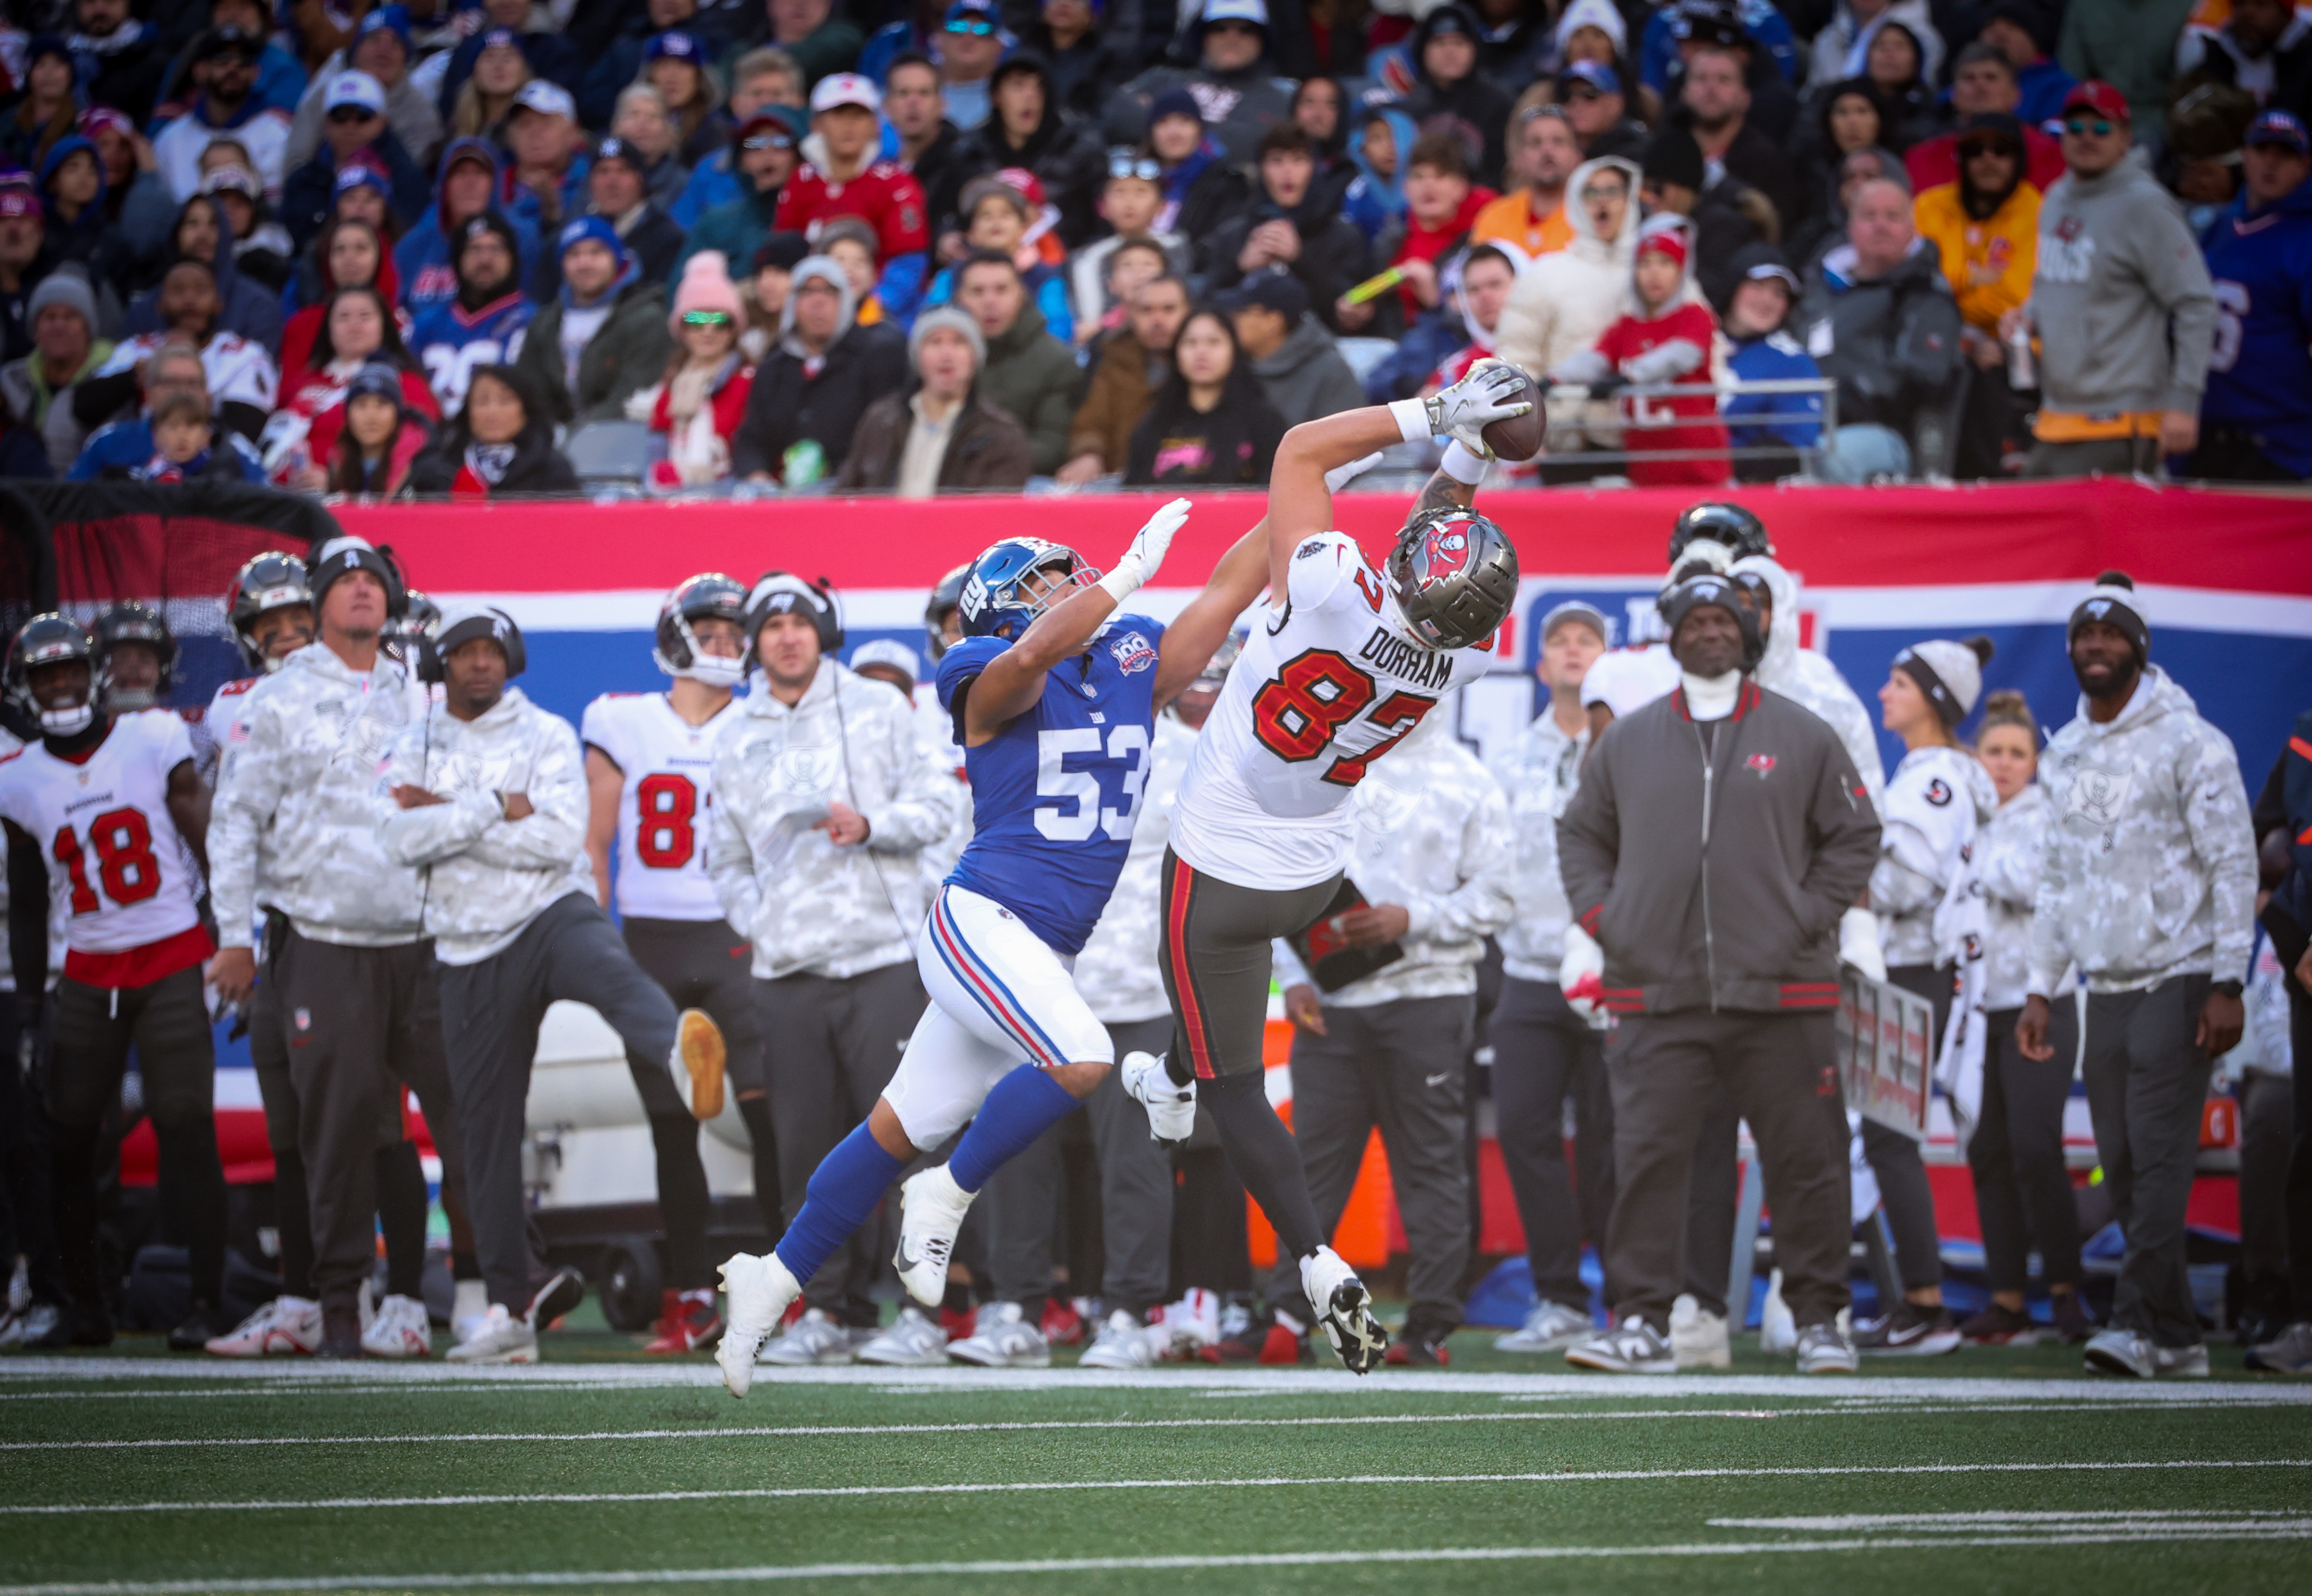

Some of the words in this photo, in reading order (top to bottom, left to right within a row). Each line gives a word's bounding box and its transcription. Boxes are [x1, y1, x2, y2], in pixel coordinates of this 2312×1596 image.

[1112, 636, 1148, 664] 100
[1359, 625, 1453, 690] DURHAM
[1252, 647, 1437, 787] 87
[636, 772, 712, 871] 8
[1033, 724, 1151, 841] 53
[52, 804, 162, 917] 18
